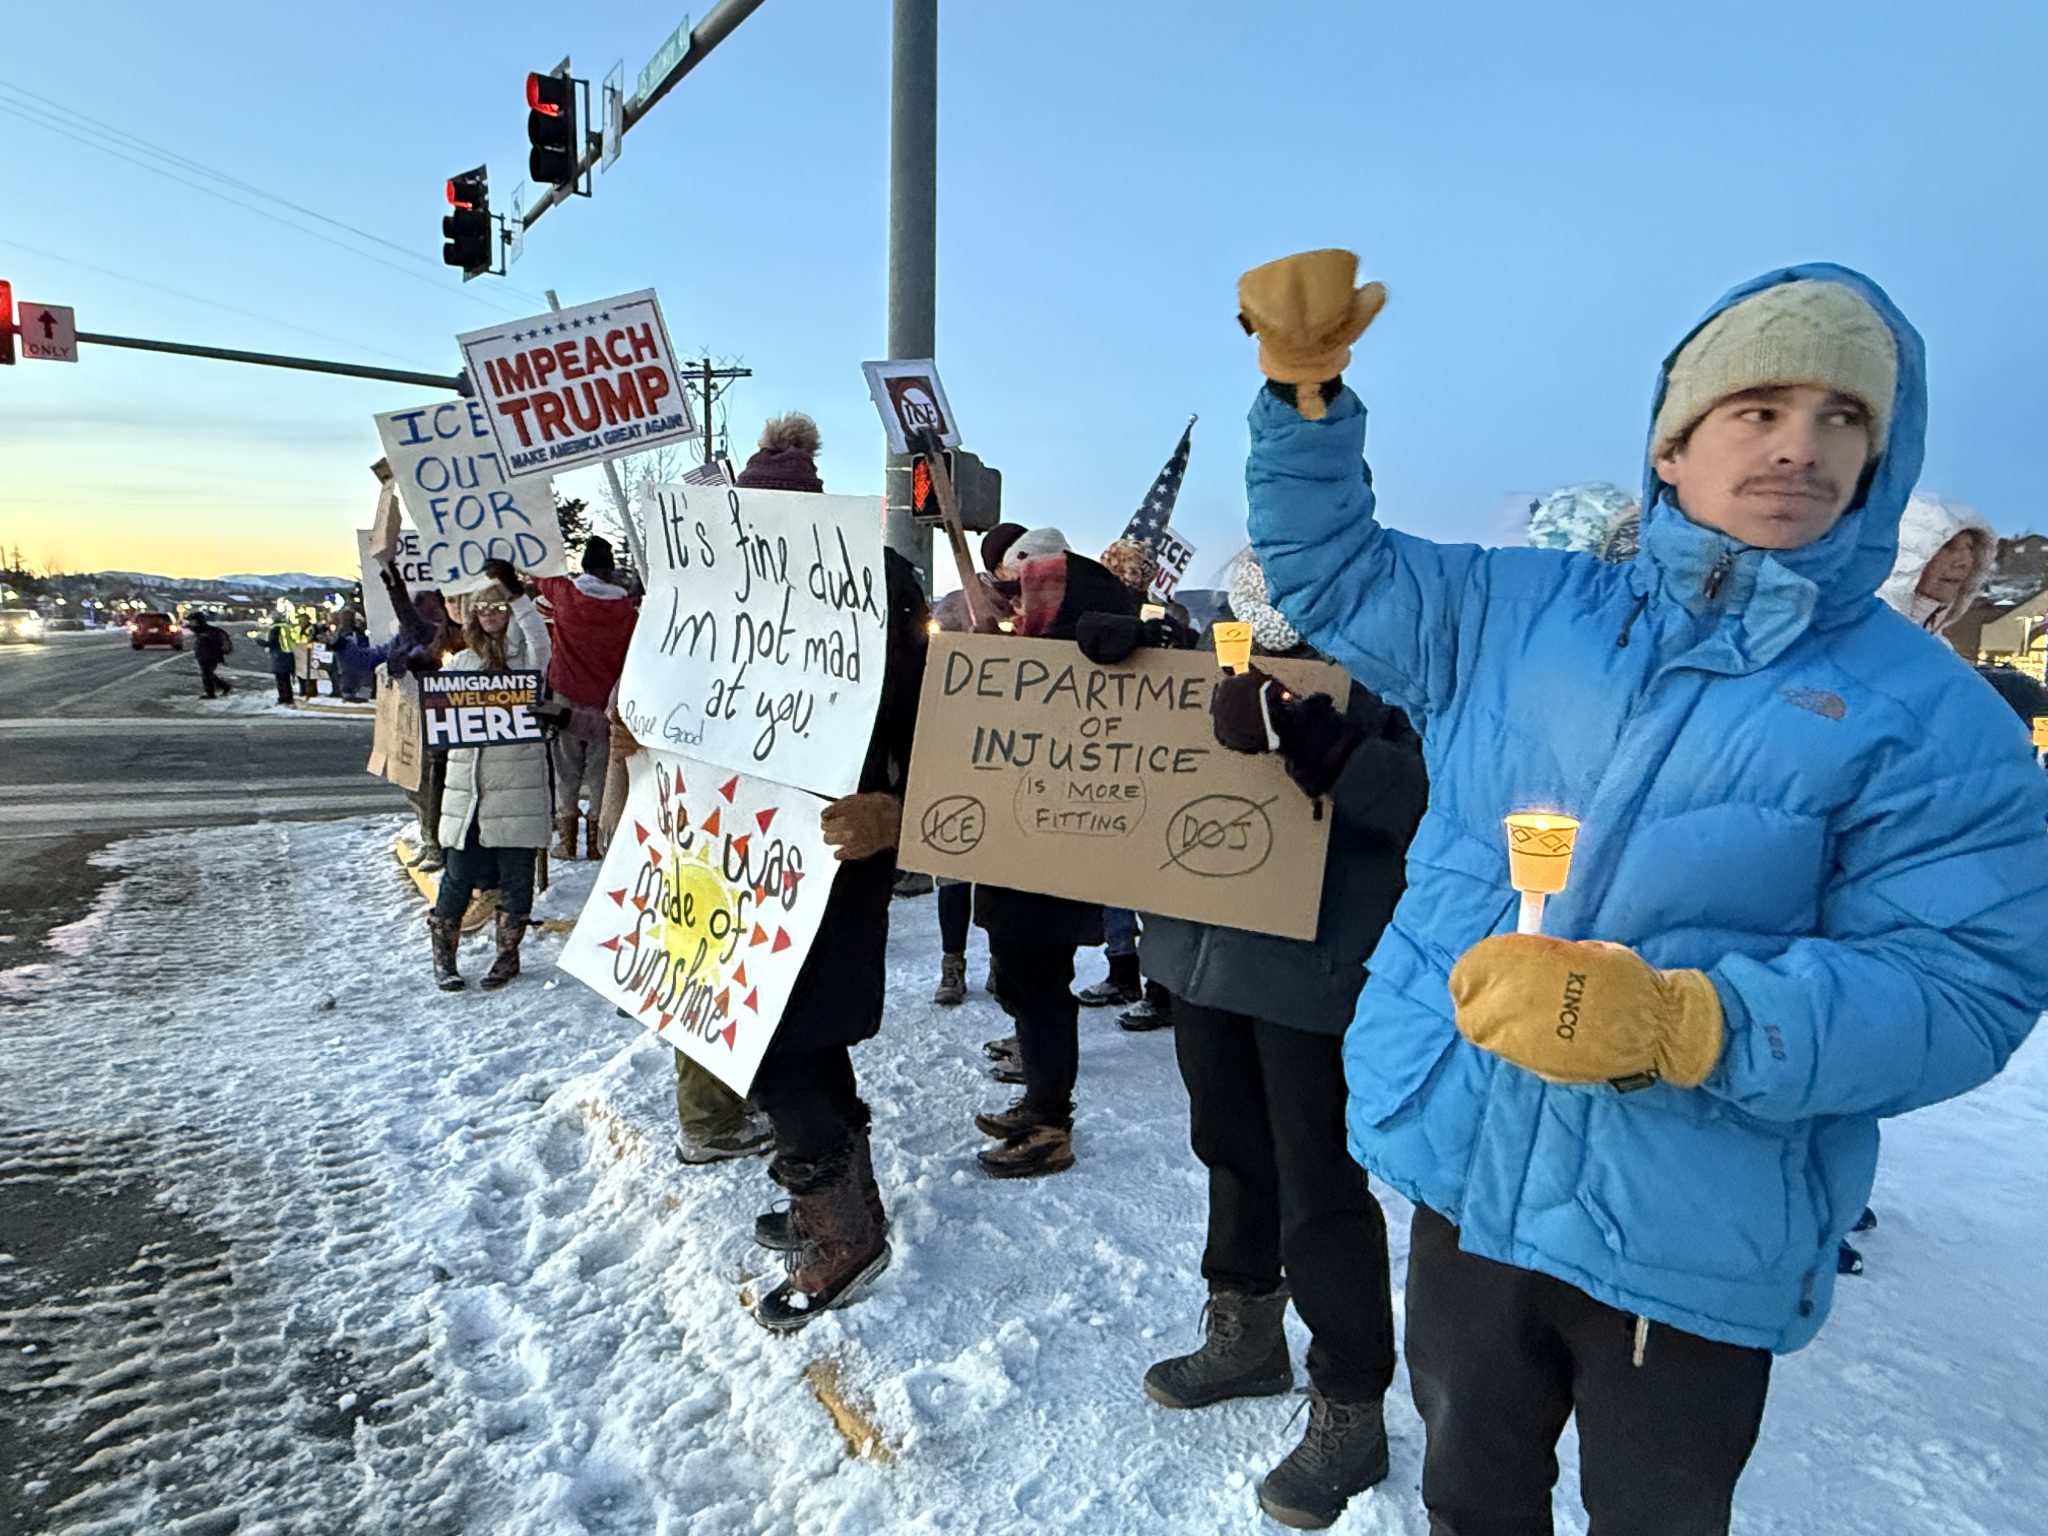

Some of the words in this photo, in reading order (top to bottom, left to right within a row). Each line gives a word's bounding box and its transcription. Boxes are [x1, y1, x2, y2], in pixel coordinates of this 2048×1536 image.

[28, 344, 71, 358] ONLY
[484, 322, 659, 398] IMPEACH
[390, 401, 490, 446] ICE
[496, 365, 670, 448] TRUMP
[904, 402, 938, 426] ICE
[510, 447, 549, 469] MAKE
[549, 434, 602, 459] AMERICA
[603, 424, 643, 446] GREAT
[429, 490, 532, 535] FOR
[427, 532, 548, 584] GOOD
[657, 491, 715, 571] It's
[727, 488, 797, 604] fine
[1156, 532, 1193, 576] ICE
[395, 562, 434, 582] CE
[1154, 566, 1180, 596] UT
[731, 584, 797, 666] not
[803, 611, 862, 685] mad
[423, 674, 538, 693] IMMIGRANTS
[446, 689, 537, 707] WELCOME
[704, 659, 746, 721] at
[943, 650, 1219, 715] DEPARTME
[425, 704, 542, 745] HERE
[662, 702, 705, 746] Good
[1079, 716, 1123, 739] OF
[971, 725, 1211, 775] INJUSTICE
[1068, 780, 1142, 800] MORE
[930, 809, 979, 845] ICE
[1035, 808, 1128, 833] FITTING
[1182, 813, 1254, 852] DOJ
[722, 832, 804, 913] was
[708, 889, 753, 965] of
[1556, 971, 1587, 1042] KINCO
